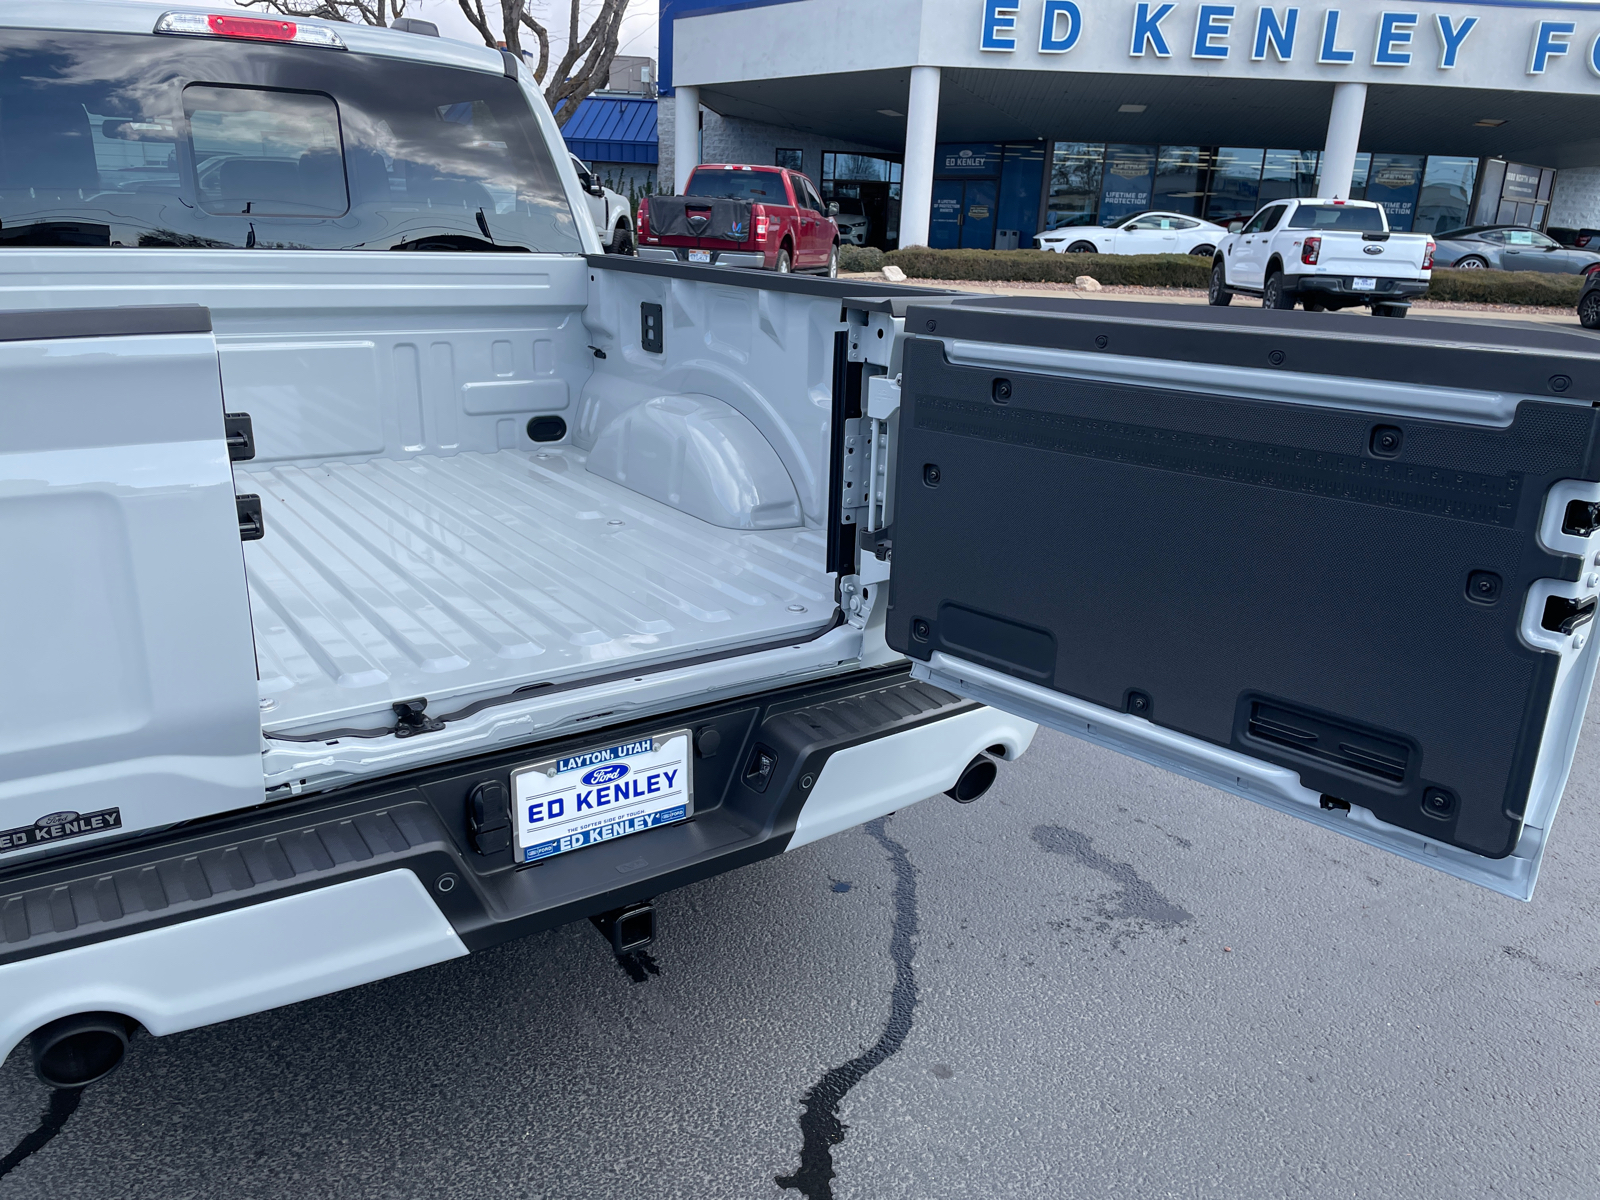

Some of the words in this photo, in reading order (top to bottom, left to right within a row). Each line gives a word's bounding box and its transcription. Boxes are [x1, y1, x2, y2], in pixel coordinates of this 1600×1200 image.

[980, 0, 1083, 54] ED
[1129, 1, 1480, 69] KENLEY
[945, 158, 955, 166] ED
[957, 158, 986, 166] KENLEY
[559, 749, 615, 772] LAYTON,
[618, 740, 651, 758] UTAH
[590, 767, 621, 785] Ford
[528, 797, 564, 824] ED
[576, 769, 679, 812] KENLEY
[0, 832, 27, 848] ED
[35, 812, 118, 841] KENLEY
[45, 813, 69, 825] Ford
[538, 846, 553, 854] FORD
[560, 834, 584, 851] ED
[589, 813, 656, 842] KENLEY
[567, 826, 579, 834] THE
[580, 820, 602, 831] SOFTER
[603, 817, 617, 825] SIDE
